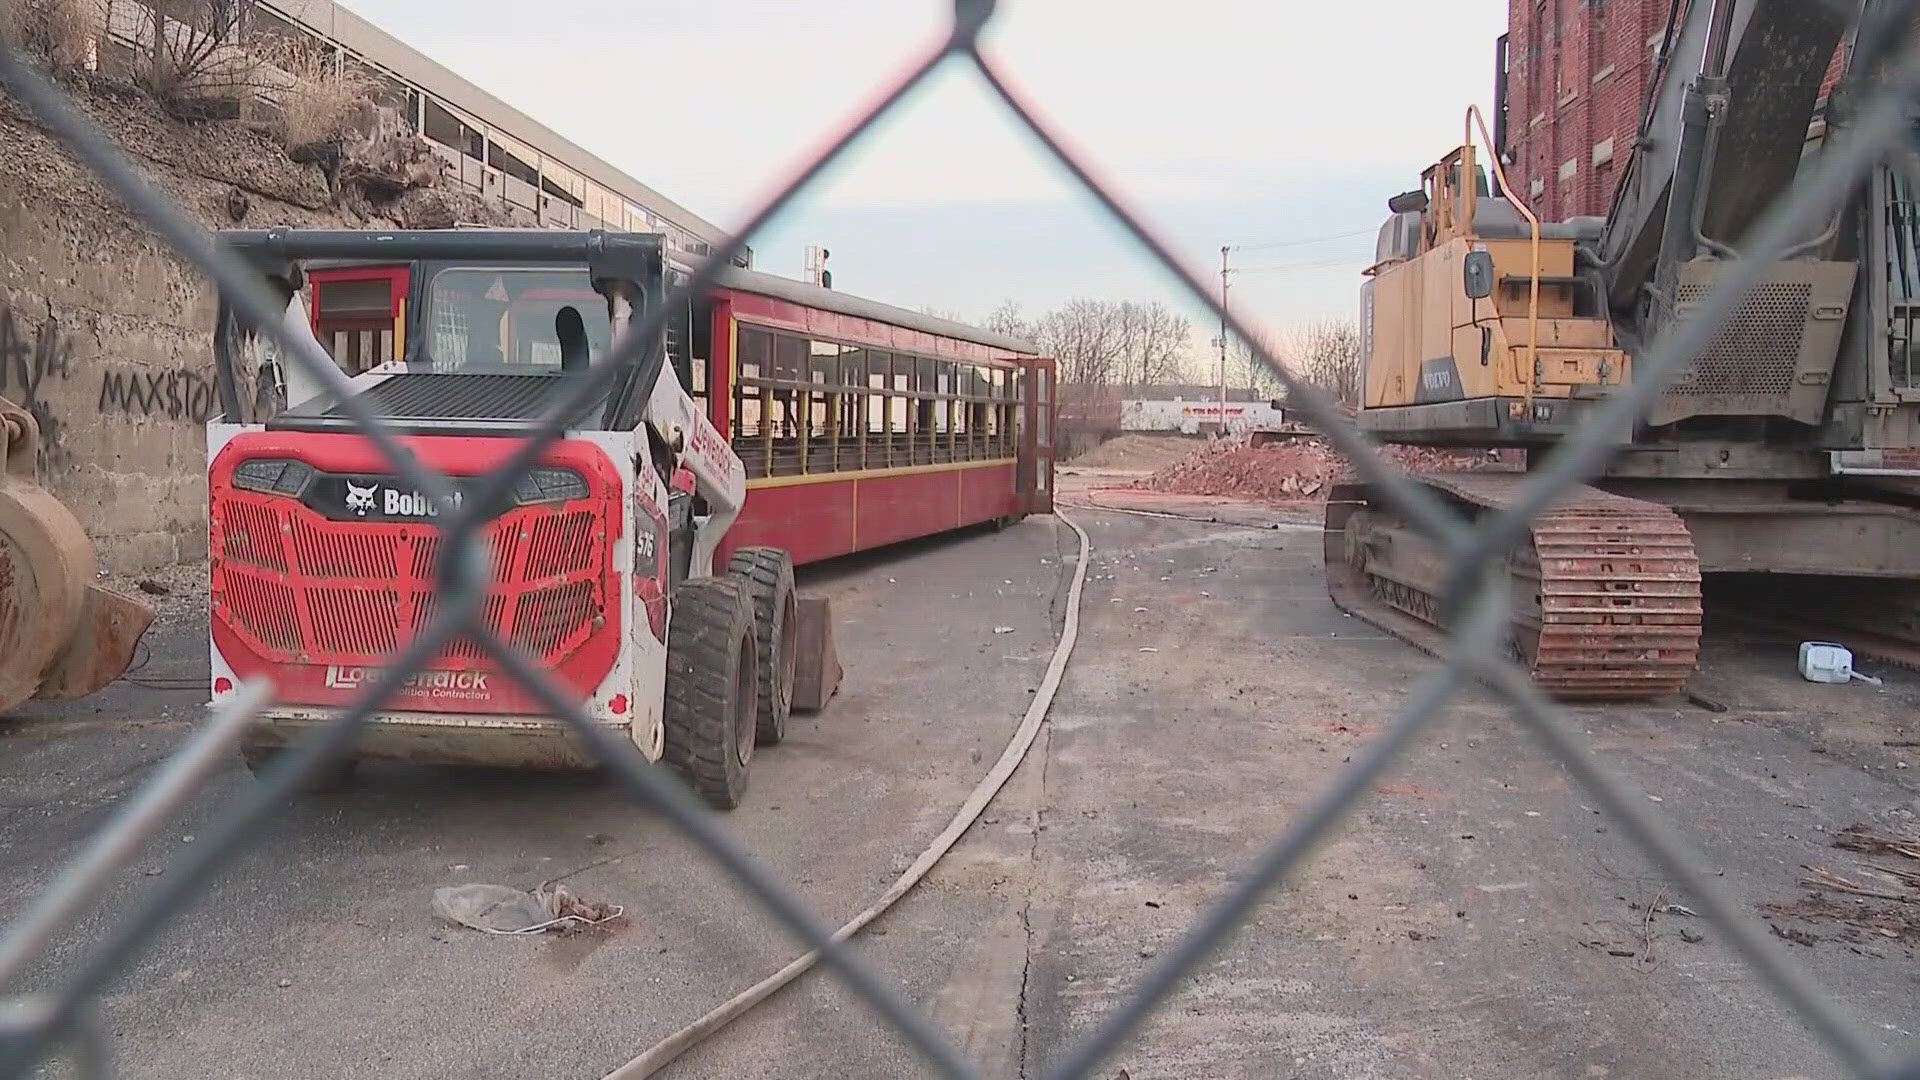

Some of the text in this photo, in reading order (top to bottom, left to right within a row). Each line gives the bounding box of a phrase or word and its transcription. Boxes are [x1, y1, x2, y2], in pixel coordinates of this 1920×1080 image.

[1424, 371, 1450, 391] VOLVO
[398, 687, 491, 701] olition Contractors
